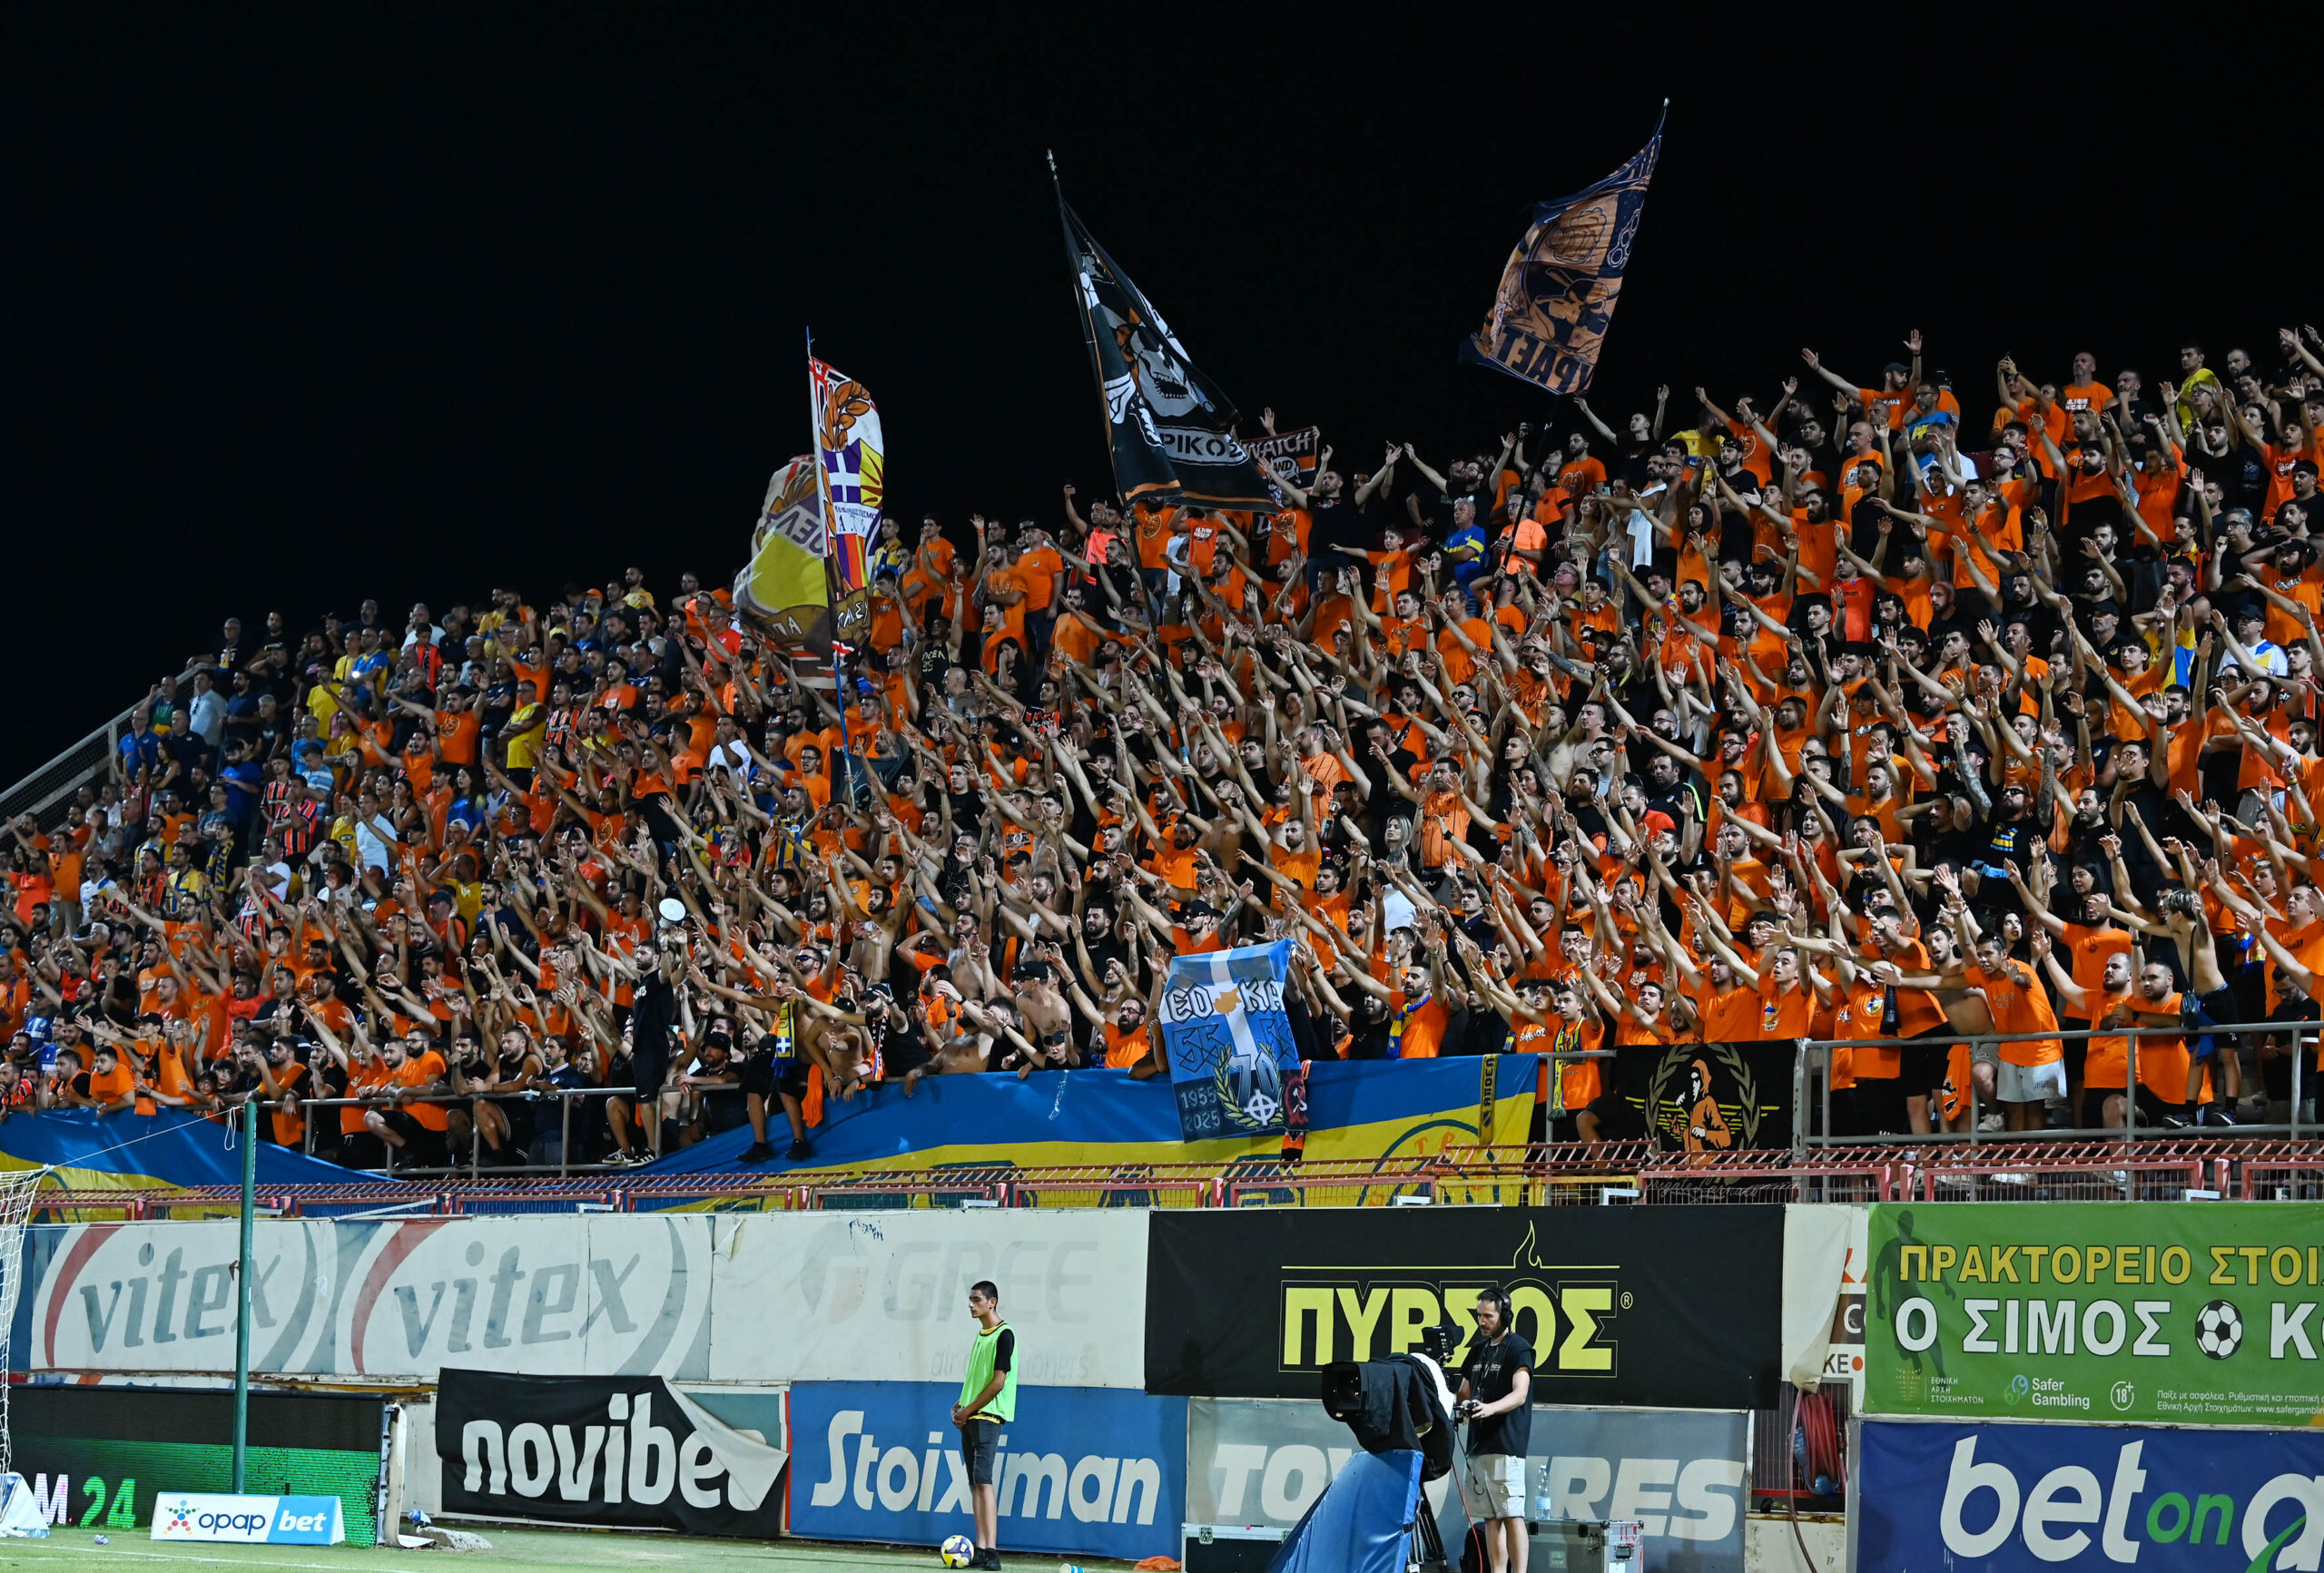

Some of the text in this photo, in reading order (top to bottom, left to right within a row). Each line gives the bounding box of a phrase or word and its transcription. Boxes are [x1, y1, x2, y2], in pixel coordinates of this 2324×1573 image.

[1180, 1084, 1218, 1110] 1955
[1184, 1108, 1221, 1133] 2025
[1899, 1244, 2191, 1285] ΠΡΑΚΤΟΡΕΙΟ
[2209, 1245, 2324, 1286] ΣΤΟΙ
[882, 1240, 1099, 1324] GREE
[80, 1242, 281, 1354] vitex
[393, 1240, 641, 1360] vitex
[1895, 1296, 2324, 1361] Ο ΣΙΜΟΣ Κ
[1931, 1377, 1958, 1385] ΕΘΝΙΚΗ
[2032, 1378, 2064, 1391] Safer
[1931, 1395, 1984, 1404] ΣΤΟΙΧΗΜΑΤΩΝ
[2032, 1392, 2090, 1410] Gambling
[2157, 1390, 2178, 1400] Παίξε
[2179, 1392, 2188, 1401] με
[2271, 1394, 2283, 1402] και
[2157, 1401, 2181, 1412] Εθνική
[2183, 1402, 2203, 1412] Αρχή
[1525, 1455, 1746, 1541] IRES
[1940, 1434, 2147, 1564] bet
[2146, 1491, 2235, 1545] on
[198, 1509, 326, 1536] opap bet
